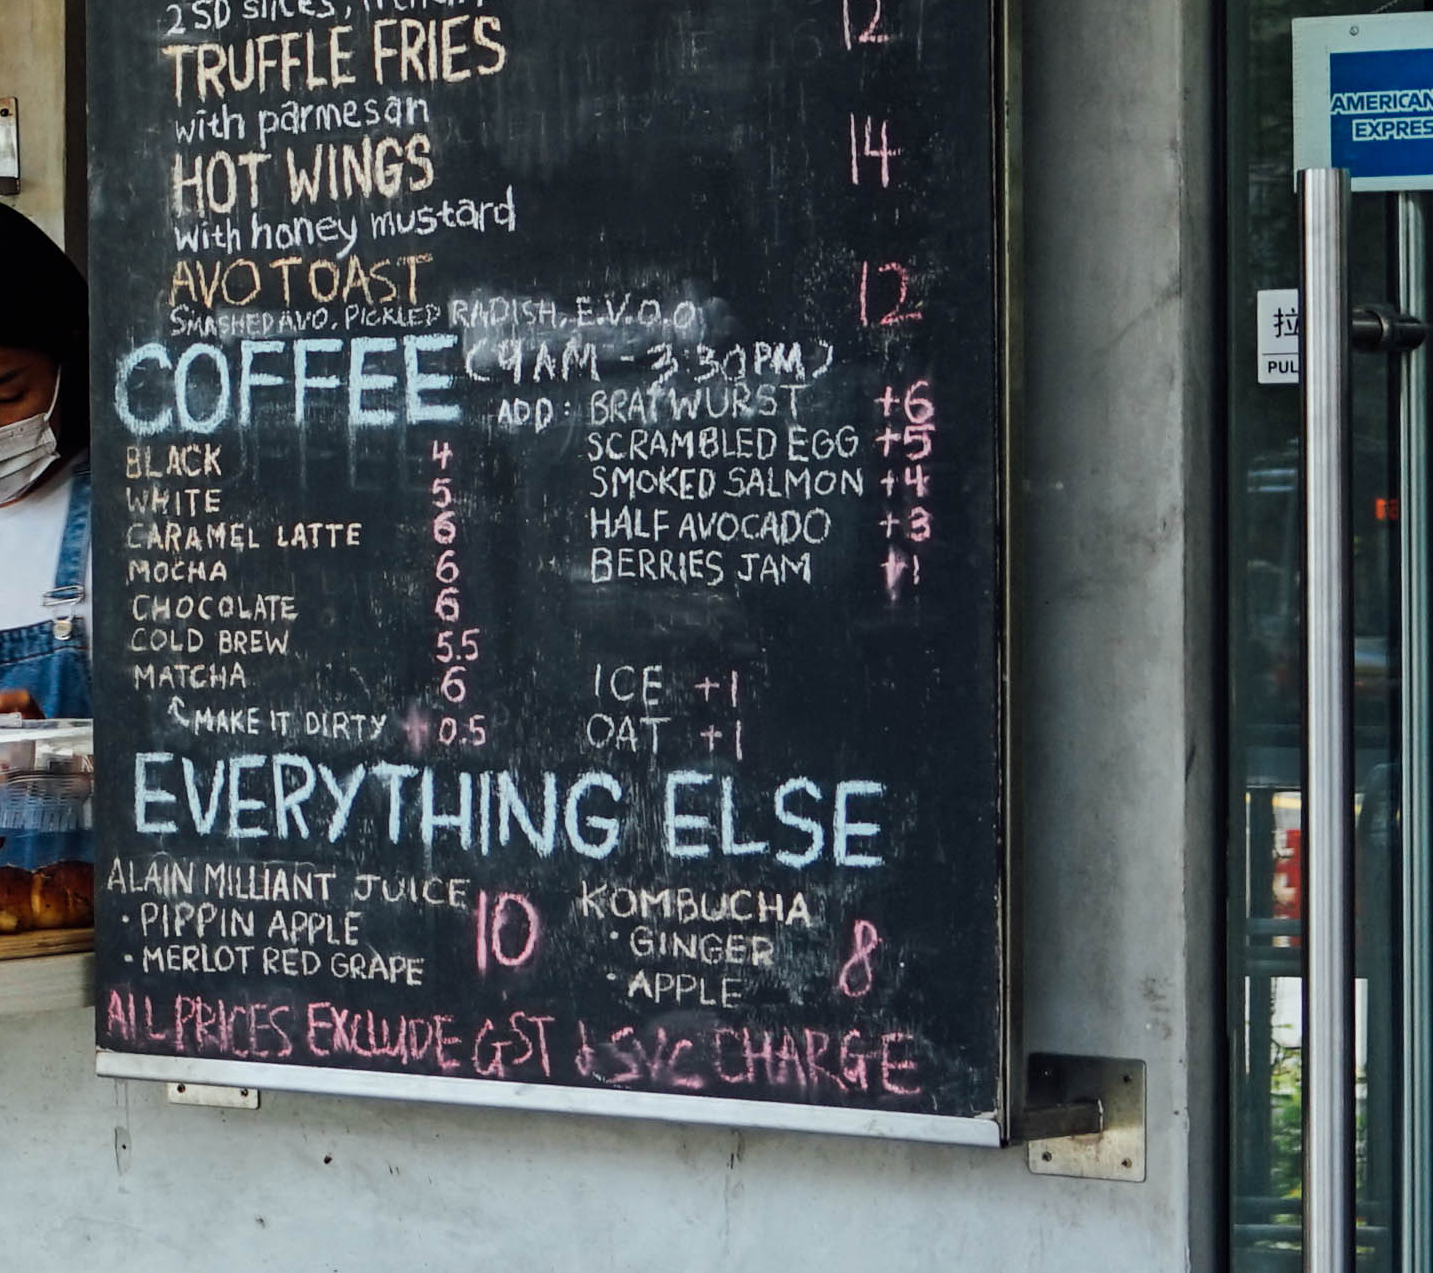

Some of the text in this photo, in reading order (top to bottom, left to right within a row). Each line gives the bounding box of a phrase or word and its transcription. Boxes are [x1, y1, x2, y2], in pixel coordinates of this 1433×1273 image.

[160, 15, 507, 107] TRUFFLE FRIES
[176, 94, 429, 150] with parmesan
[1355, 119, 1433, 138] EXPRES
[849, 112, 901, 188] 14
[171, 133, 435, 218] HOT WINGS
[175, 184, 516, 258] with honey mustard
[270, 253, 433, 307] TOAST
[859, 260, 923, 326] 12
[113, 333, 461, 435] COFFEE
[1268, 360, 1298, 373] PUL
[126, 444, 222, 479] BLACK
[586, 426, 860, 464] SCRAMBLED EGG
[126, 487, 222, 514] WHITE
[590, 466, 864, 500] SMOKED SALMON
[126, 522, 362, 551] CARAMEL LATTE
[589, 505, 831, 545] HALF AVOCADO
[590, 547, 812, 586] BERRIES JAM
[132, 594, 298, 622] CHOCOLATE
[130, 627, 289, 655] COLD BREW
[134, 662, 247, 690] MATCHA
[134, 752, 888, 870] EVERYTHING ELSE
[580, 881, 814, 927] KOMBUCHA
[141, 902, 776, 967] PIPPIN APPLE GINGER
[473, 888, 542, 975] 10
[143, 944, 426, 987] MERLOT RED GRAPE
